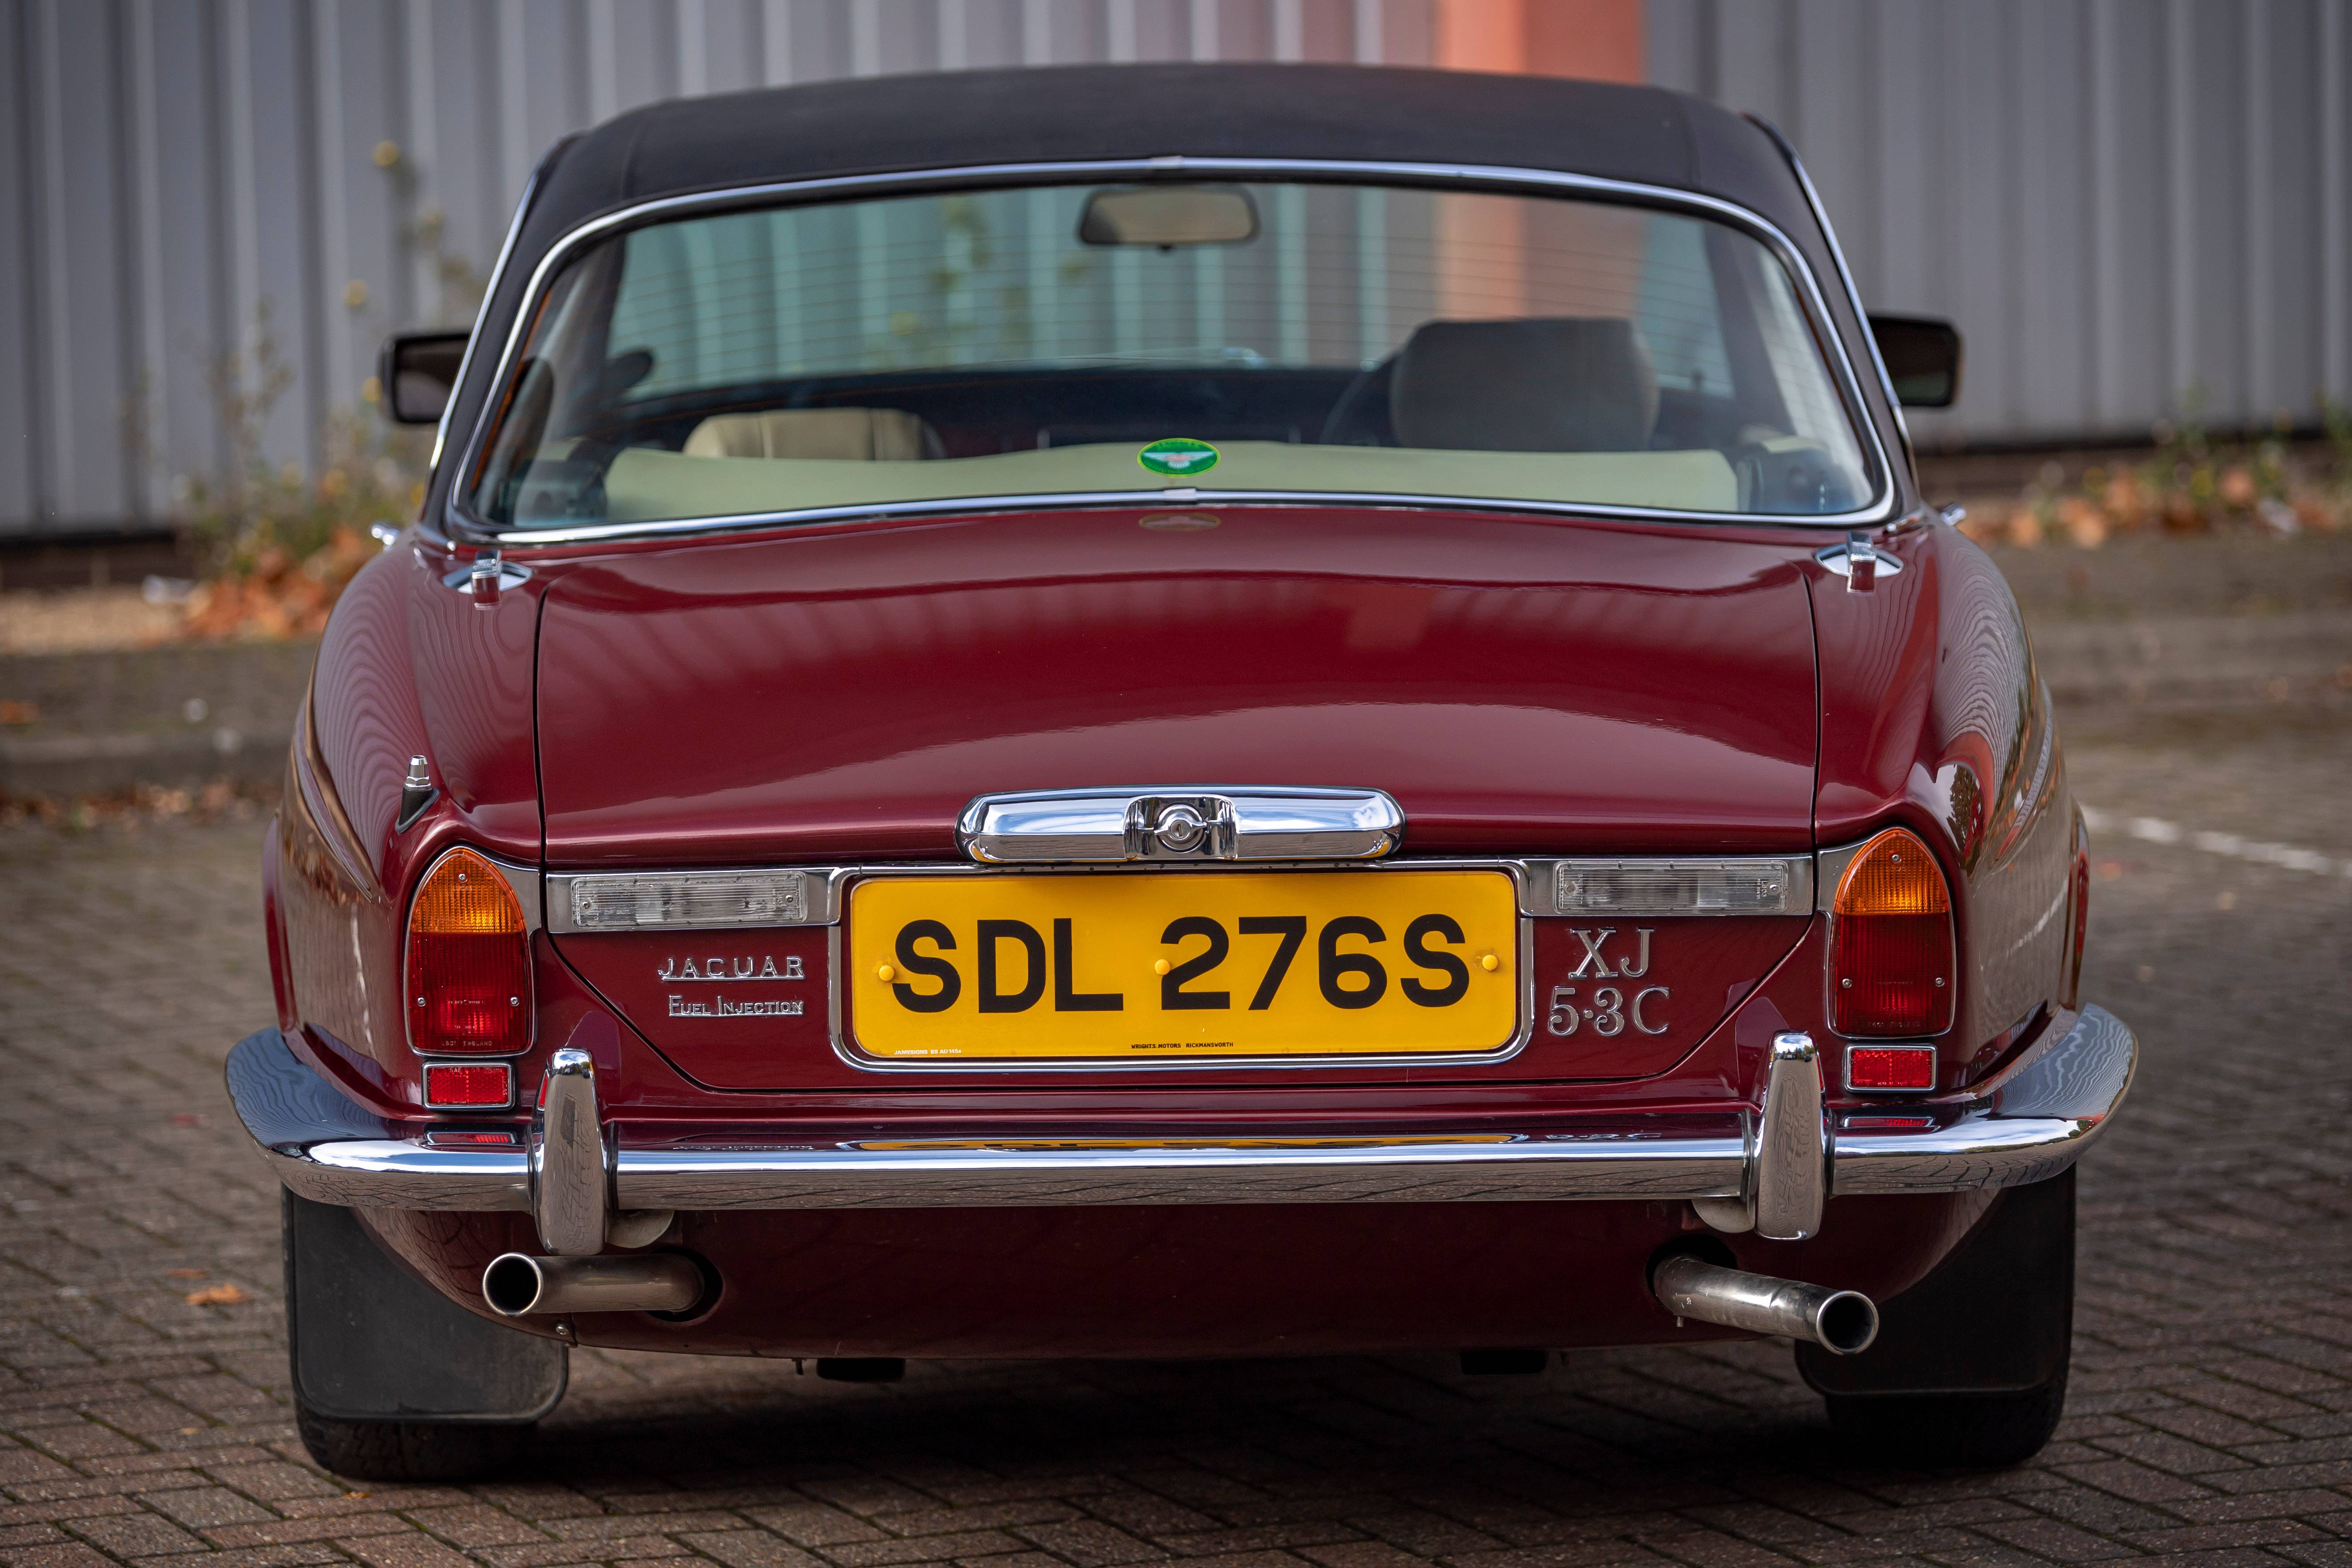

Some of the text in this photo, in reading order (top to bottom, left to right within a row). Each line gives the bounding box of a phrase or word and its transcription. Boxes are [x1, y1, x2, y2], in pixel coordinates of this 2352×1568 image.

[658, 955, 805, 978] JAGUAR
[891, 913, 1470, 1013] SDL 276S
[1568, 927, 1655, 979] XJ
